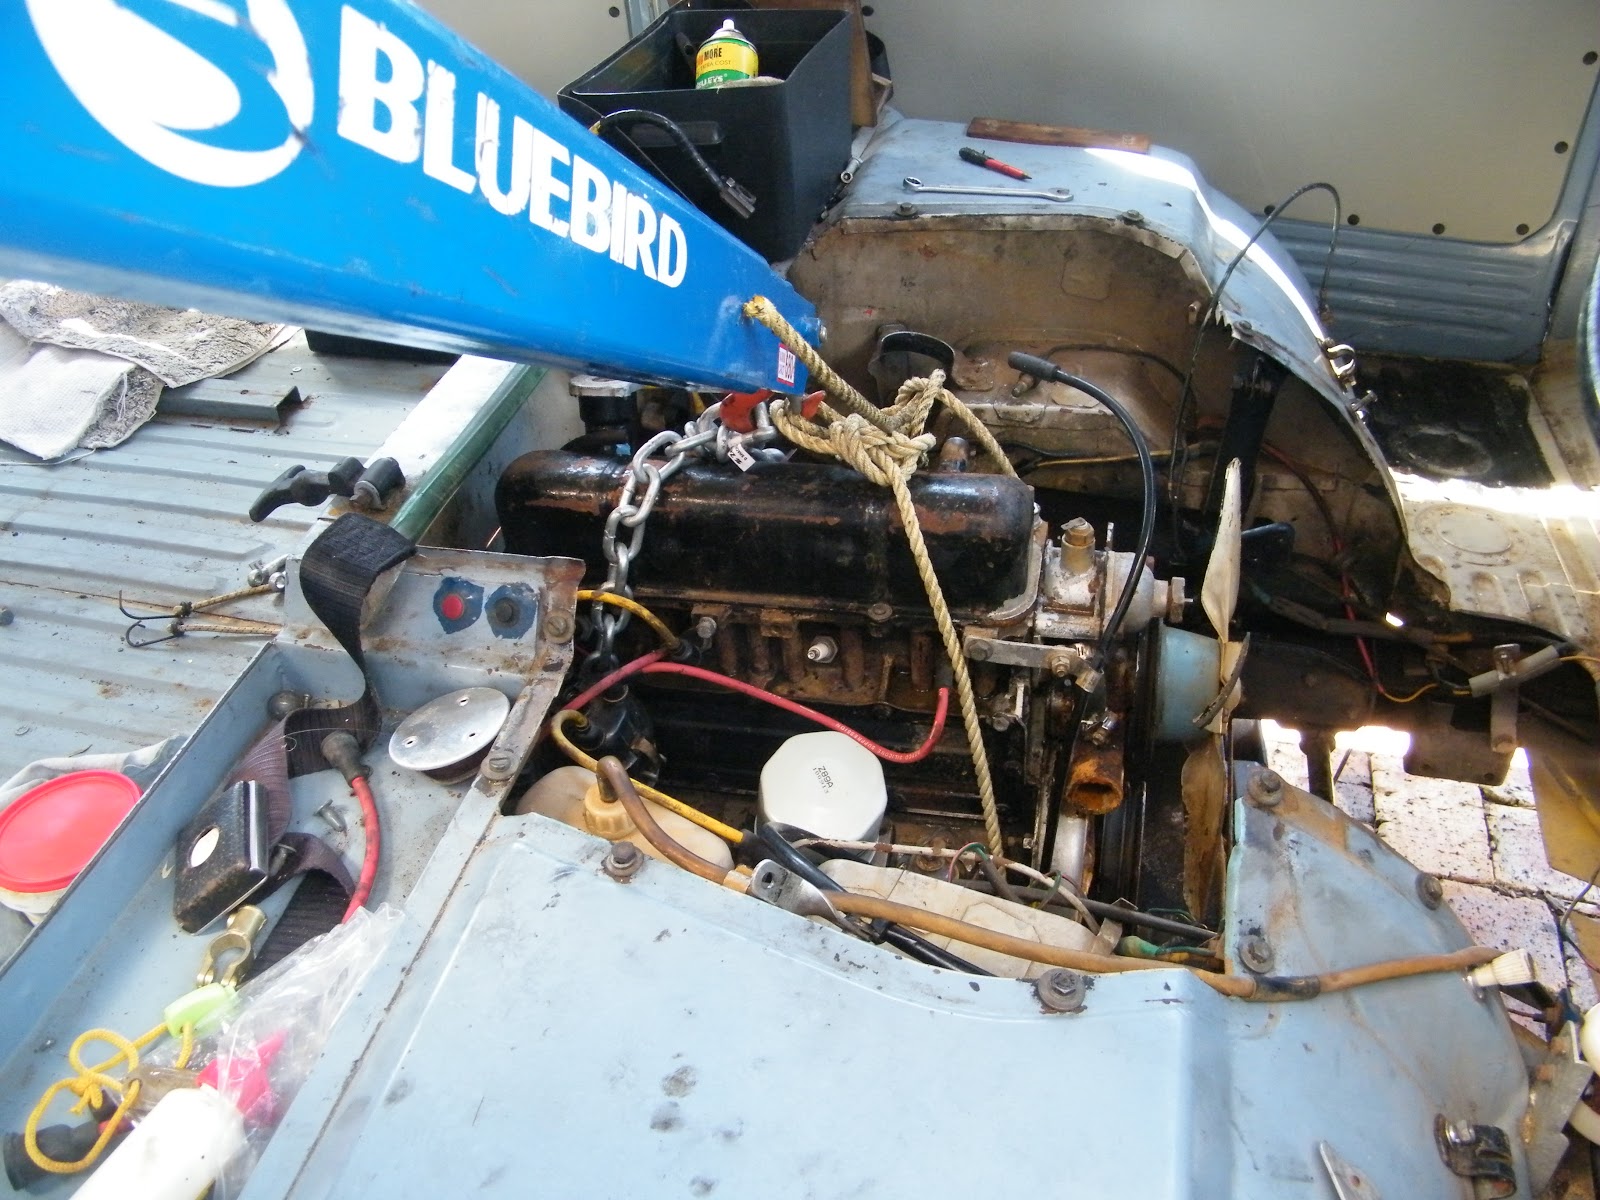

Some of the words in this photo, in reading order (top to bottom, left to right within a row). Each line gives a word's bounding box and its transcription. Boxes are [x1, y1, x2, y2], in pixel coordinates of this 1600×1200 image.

[704, 47, 722, 60] MORE
[337, 4, 688, 288] BLUEBIRD
[817, 765, 834, 788] Z89A
